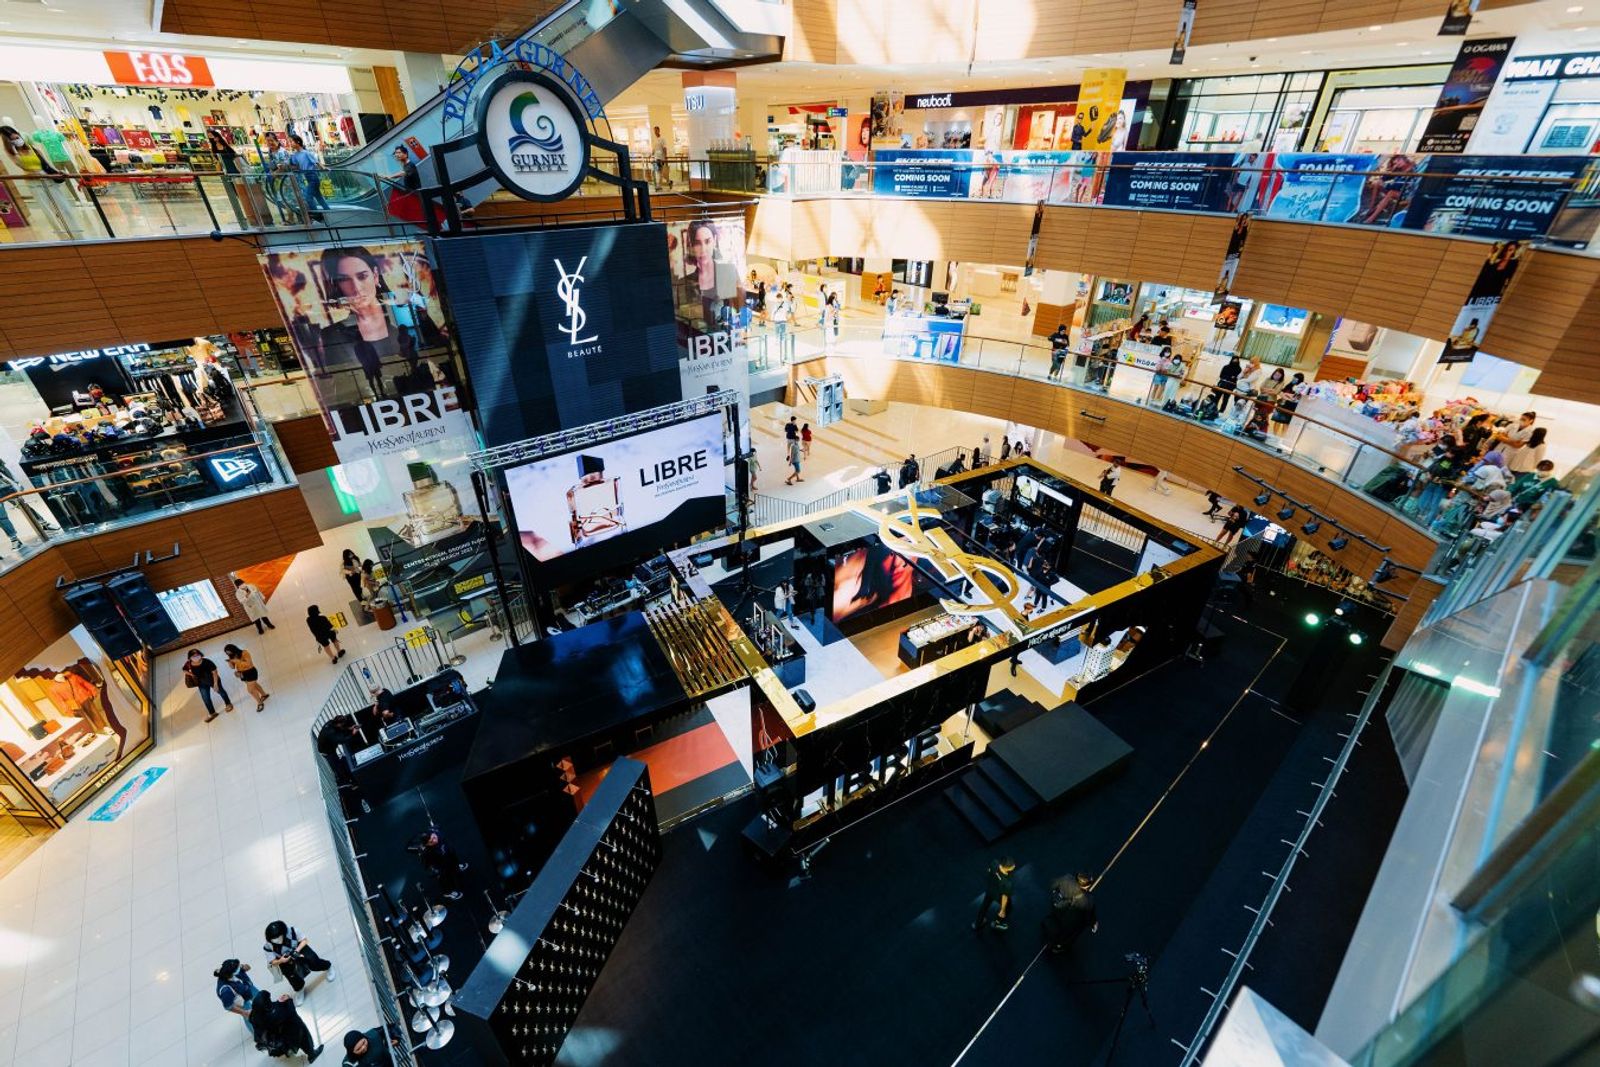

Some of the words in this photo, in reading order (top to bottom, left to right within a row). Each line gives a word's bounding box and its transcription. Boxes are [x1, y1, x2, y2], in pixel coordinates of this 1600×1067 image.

[1472, 43, 1507, 53] OGAWA
[1506, 58, 1562, 78] WAH
[443, 40, 508, 121] PLAZA
[515, 39, 605, 119] GURNEY
[917, 93, 952, 108] neubodi
[511, 154, 567, 166] GURNEY
[894, 174, 925, 182] COMING
[927, 174, 951, 182] SOON
[1130, 181, 1168, 190] COMING
[1170, 182, 1200, 191] SOON
[1445, 195, 1504, 210] COMING
[1504, 198, 1554, 214] SOON
[554, 256, 599, 345] YSL
[680, 329, 746, 361] IBRE
[50, 349, 100, 363] NEW
[330, 386, 463, 441] LIBRE
[640, 450, 708, 487] LIBRE
